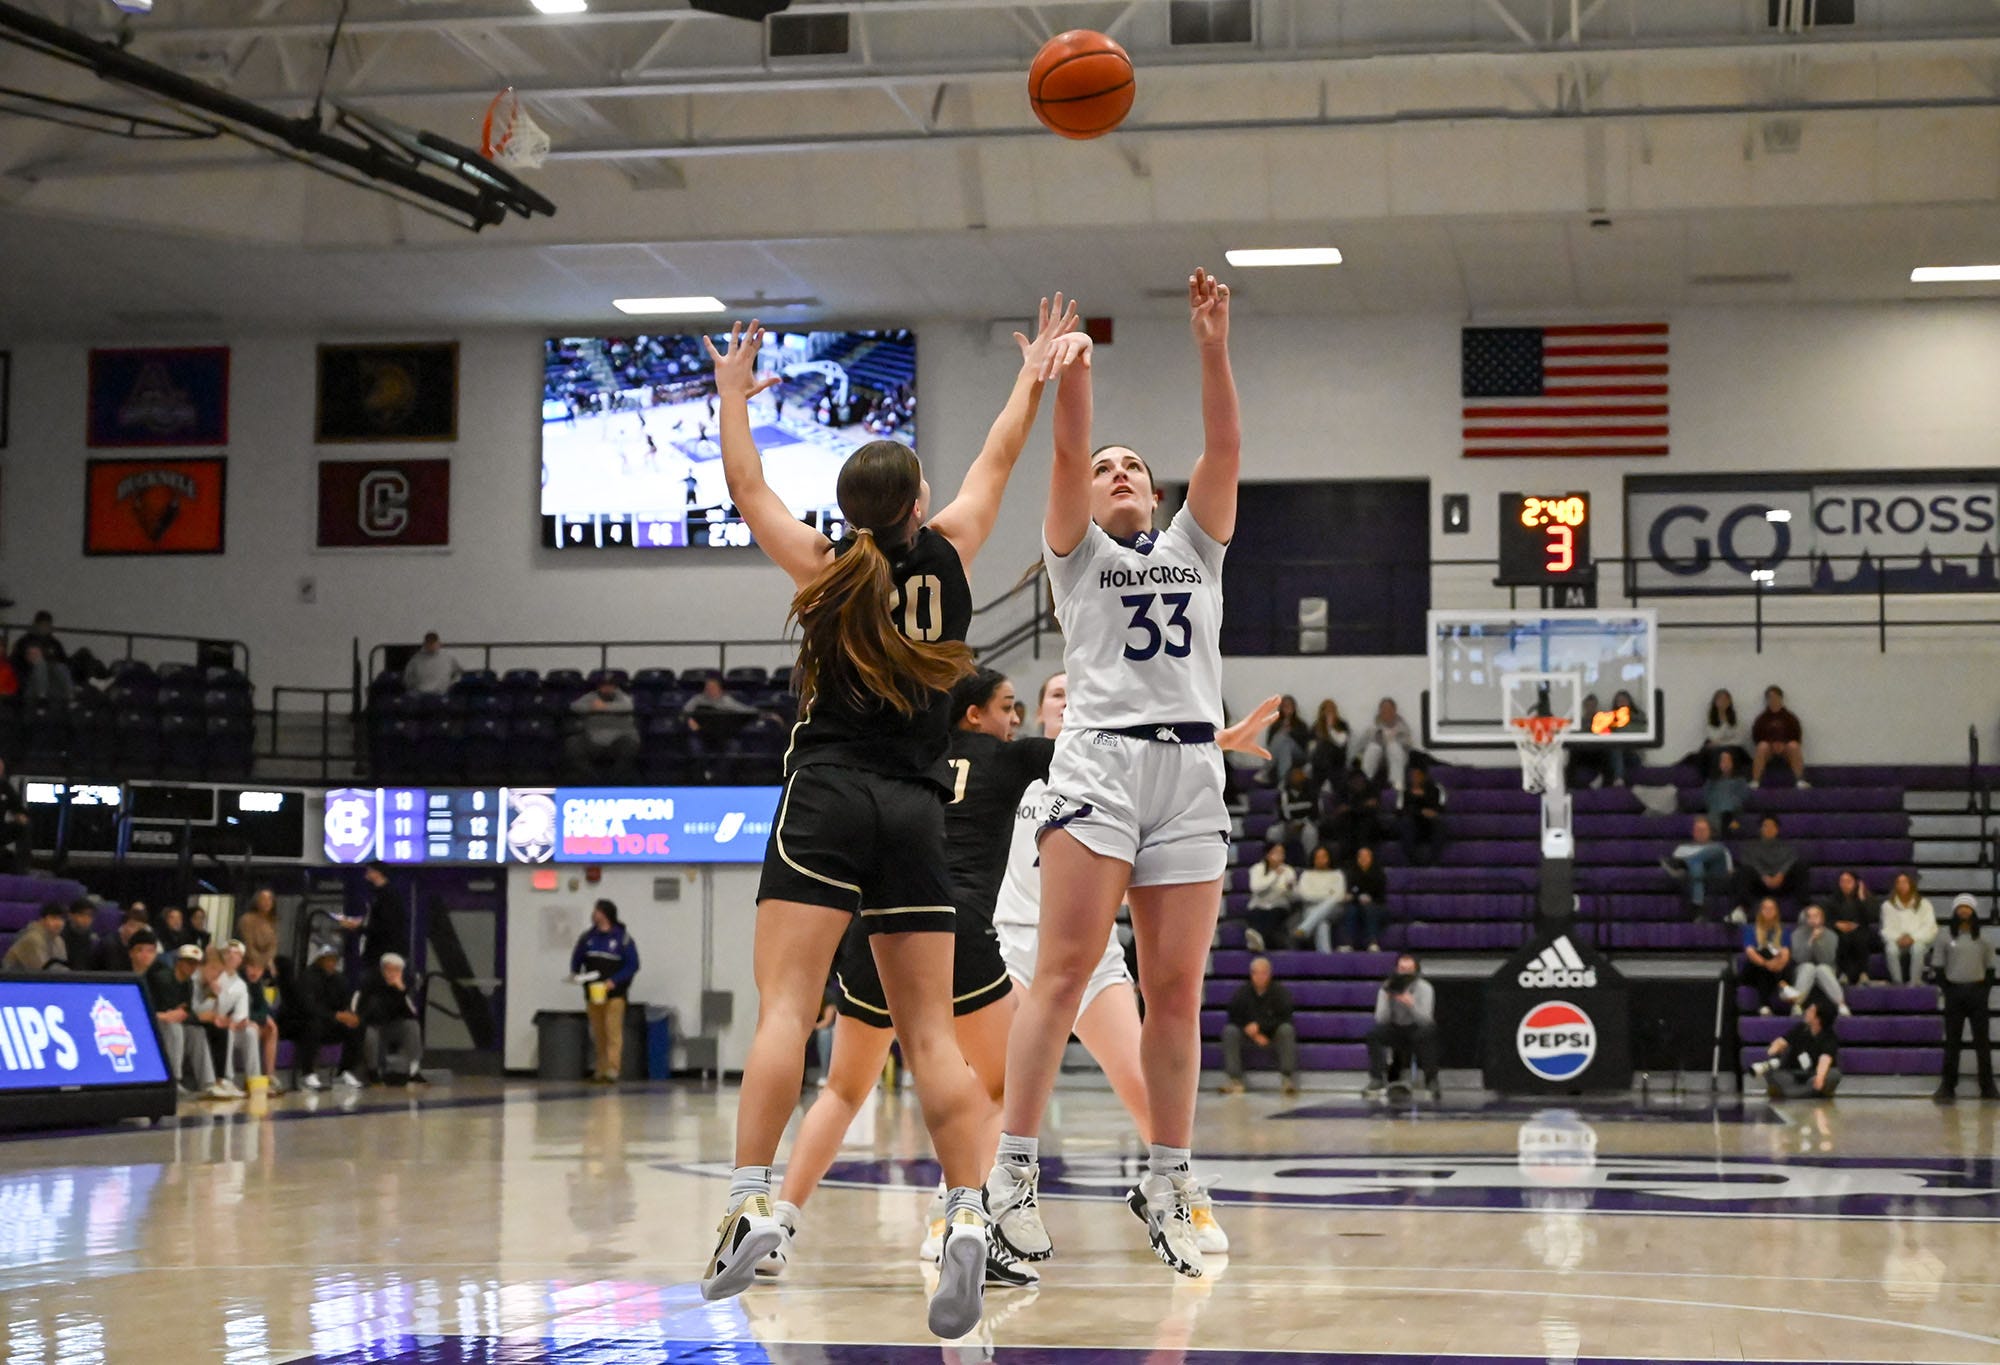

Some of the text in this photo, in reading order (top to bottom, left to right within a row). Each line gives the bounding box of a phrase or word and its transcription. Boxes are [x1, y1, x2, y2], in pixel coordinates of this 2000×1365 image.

[359, 470, 409, 537] C
[1521, 497, 1585, 527] 2:40
[1546, 525, 1572, 571] 3
[1648, 496, 1995, 577] GO CROSS
[1100, 566, 1202, 589] HOLY CROSS
[888, 573, 943, 642] 0
[1120, 592, 1193, 662] 33
[563, 798, 674, 820] CHAMPION
[1518, 965, 1597, 988] adidas
[1523, 1032, 1591, 1049] PEPSI
